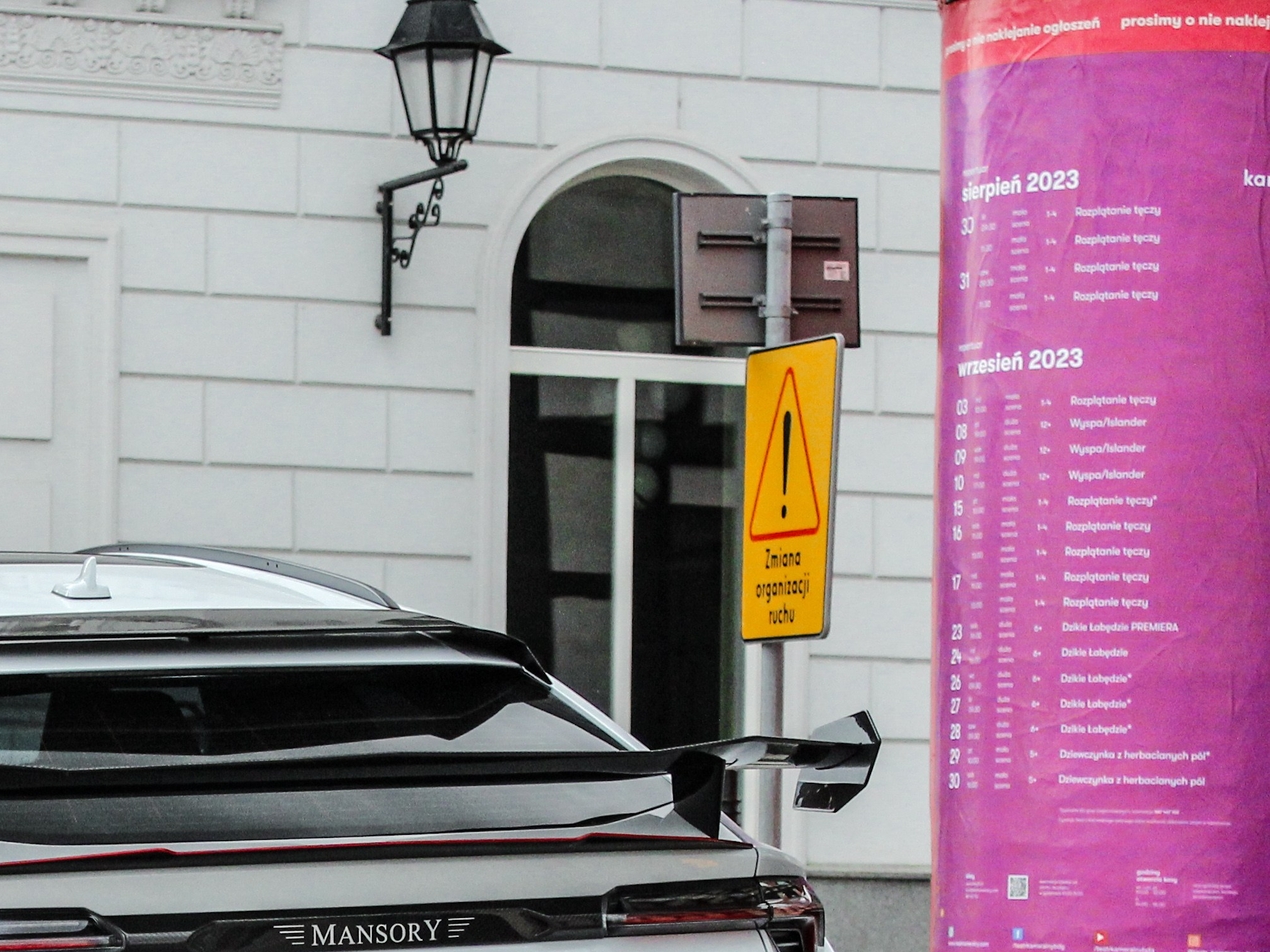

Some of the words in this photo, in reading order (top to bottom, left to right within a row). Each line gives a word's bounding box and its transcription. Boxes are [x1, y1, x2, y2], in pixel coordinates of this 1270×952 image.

[986, 23, 1041, 41] naklejanie
[1043, 17, 1101, 36] ogłoszeń
[1121, 13, 1182, 30] prosimy
[1185, 16, 1196, 27] o
[1199, 13, 1223, 27] nie
[962, 174, 1022, 203] sierpień
[1026, 169, 1080, 192] 2023
[960, 272, 970, 290] 31
[958, 351, 1023, 377] wrzesień
[1028, 347, 1084, 370] 2023
[956, 399, 968, 416] 03
[1070, 417, 1147, 430] Wyspa/Islander
[954, 449, 966, 465] 09
[1069, 443, 1146, 456] Wyspa/Islander
[954, 475, 965, 491] 10
[1068, 469, 1145, 482] Wyspa/Islander
[953, 500, 963, 516] 15
[952, 525, 962, 541] 16
[765, 547, 801, 570] Zmiana
[756, 572, 810, 603] organizacji
[952, 574, 962, 590] 17
[769, 603, 795, 624] ruchu
[951, 624, 963, 641] 23
[1062, 622, 1087, 632] Dzikie
[1130, 622, 1179, 632] PREMIERA
[951, 649, 962, 665] 24
[1061, 648, 1086, 657] Dzikie
[950, 674, 962, 691] 26
[1060, 673, 1086, 683] Dzikie
[950, 698, 961, 714] 27
[1060, 699, 1085, 708] Dzikie
[950, 723, 961, 740] 28
[1060, 724, 1086, 733] Dzikie
[949, 748, 960, 764] 29
[1059, 749, 1115, 761] Dziewczynka
[1124, 750, 1189, 762] herbacianych
[949, 773, 960, 789] 30
[1058, 774, 1114, 786] Dziewczynka
[1123, 776, 1188, 788] herbacianych
[311, 918, 442, 946] MANSORY
